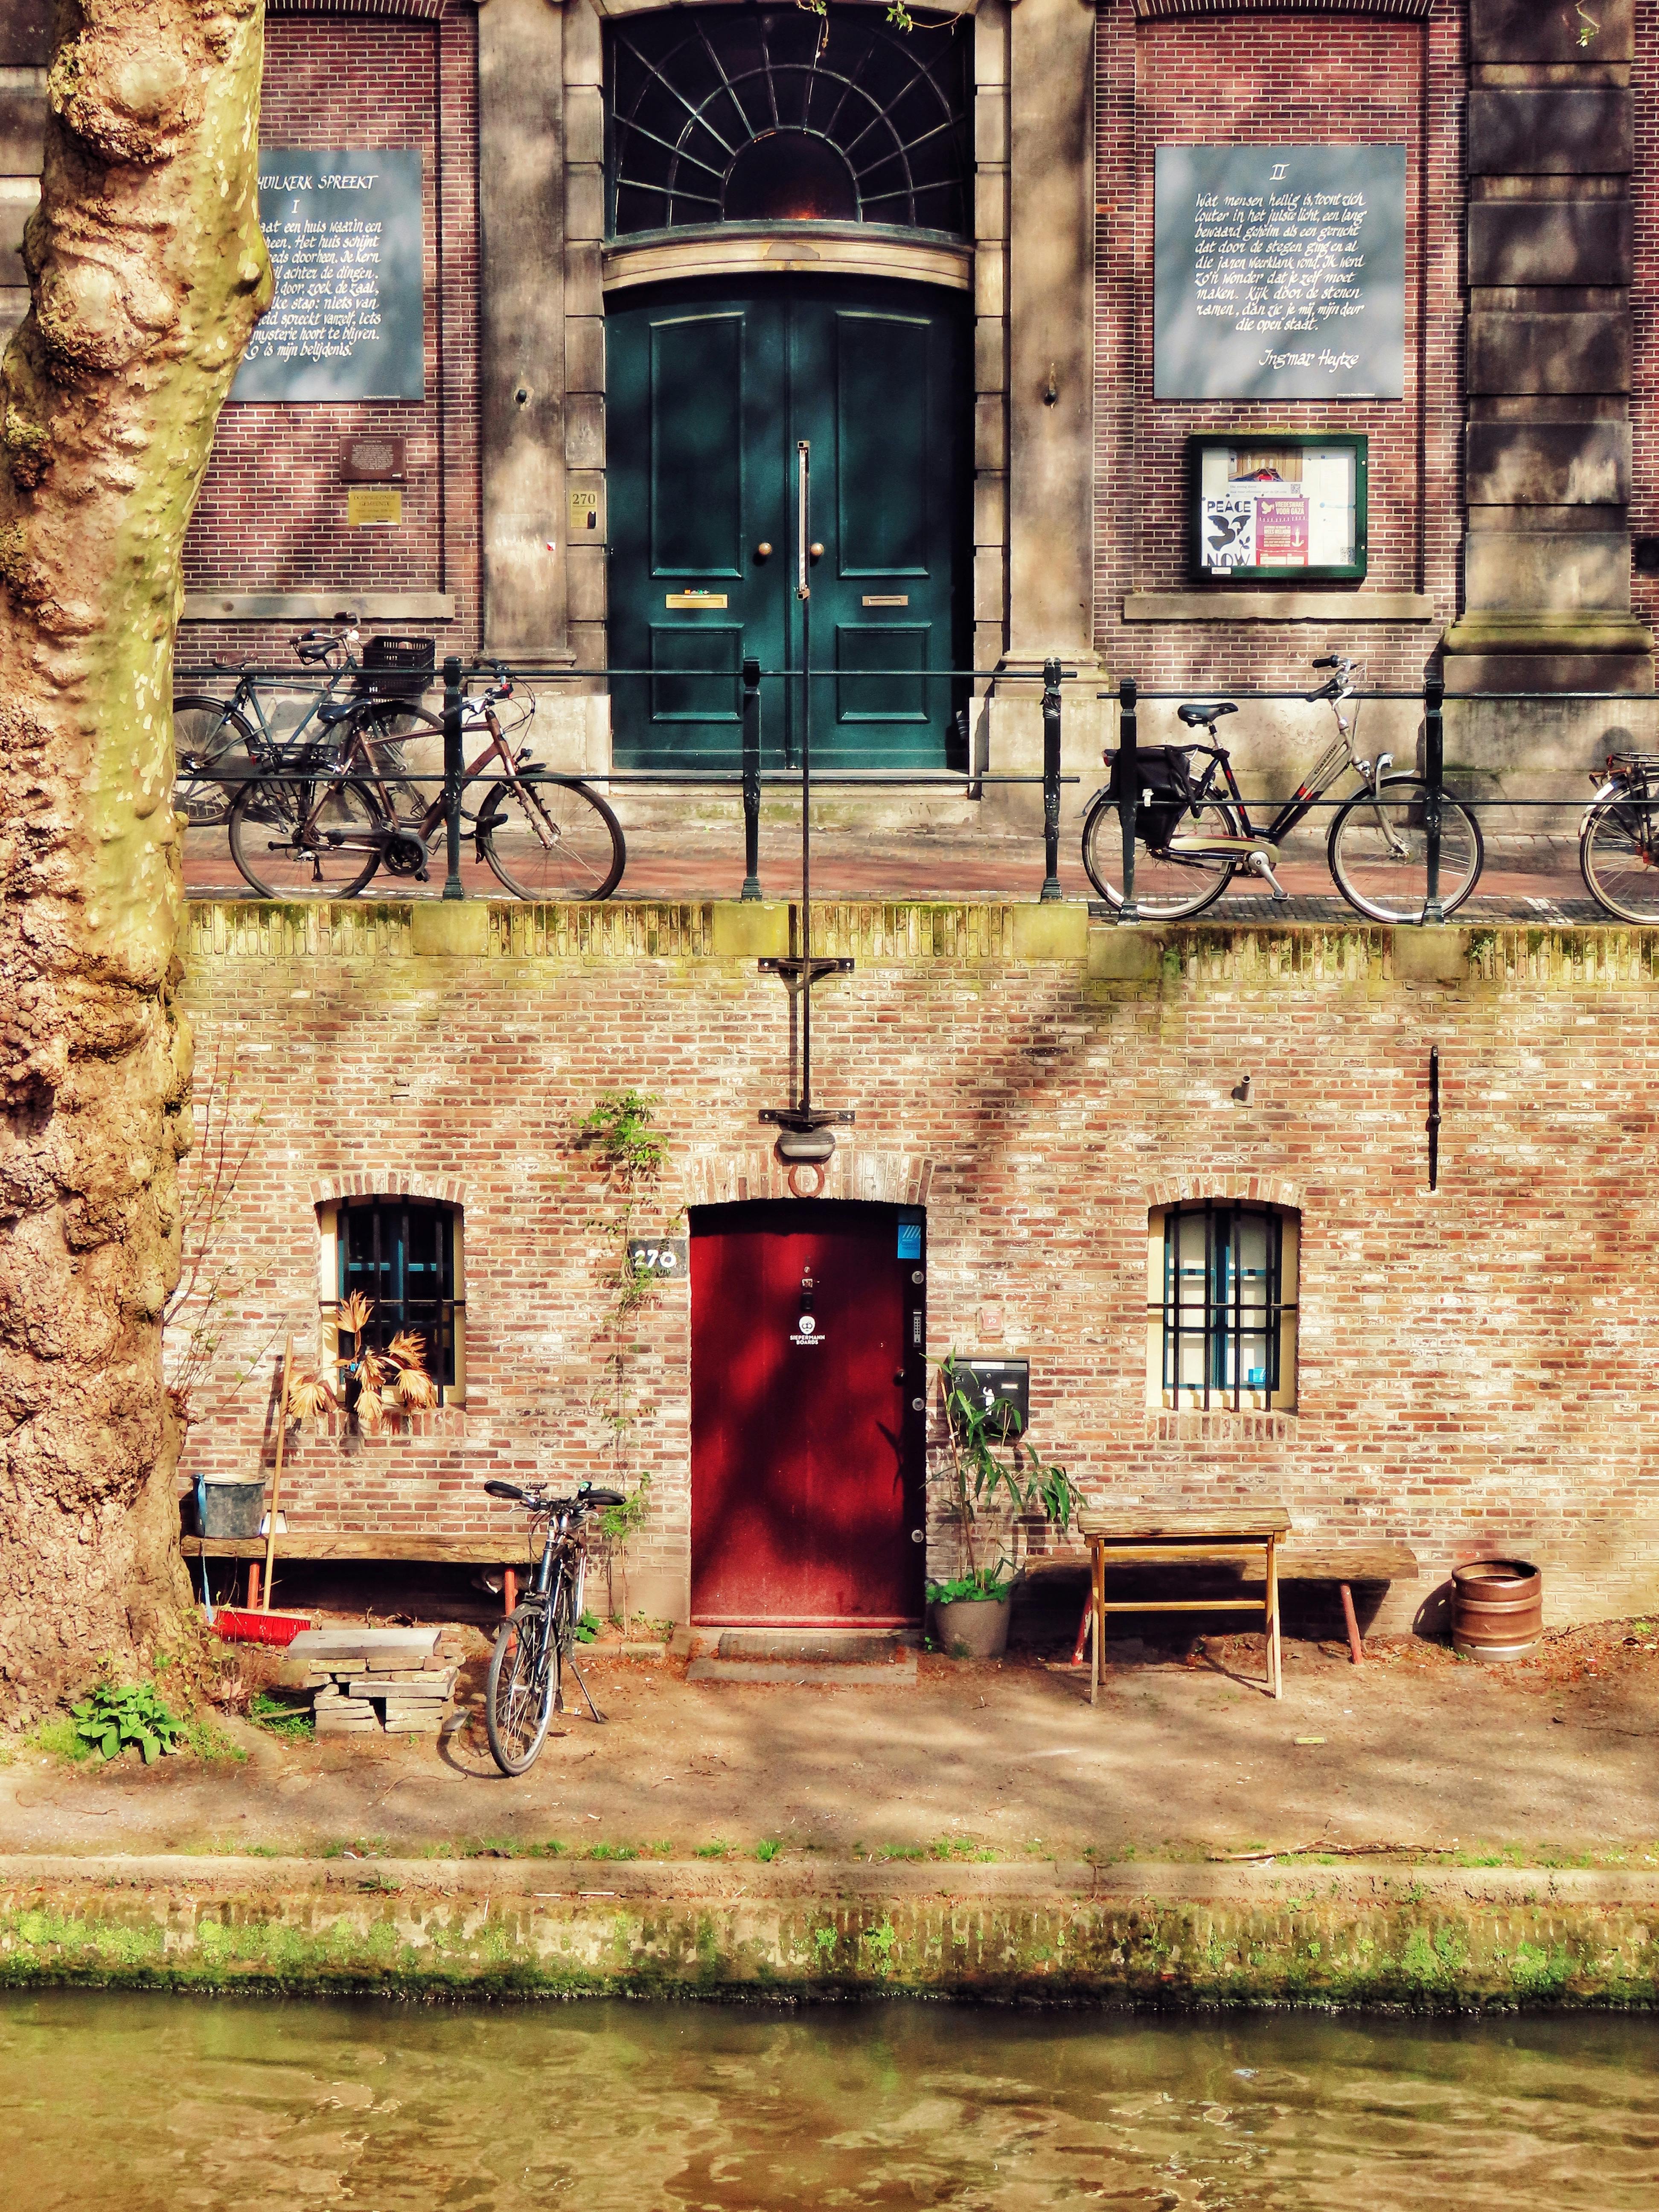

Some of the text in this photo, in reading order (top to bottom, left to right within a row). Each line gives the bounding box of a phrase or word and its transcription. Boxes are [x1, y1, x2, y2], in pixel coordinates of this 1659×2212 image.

[1269, 163, 1291, 181] II
[258, 175, 379, 191] HUILKERK SPREEKT
[291, 200, 300, 213] I
[1196, 192, 1219, 207] Wat
[1224, 196, 1264, 207] mensen
[1314, 192, 1342, 206] toont
[1342, 192, 1366, 206] zich
[260, 218, 383, 233] aat een huis waarin een
[1195, 207, 1368, 228] louter in het juiste licht, een lang
[1194, 223, 1361, 242] bewaard geheim als een gerucht
[266, 235, 381, 252] heen. Het huis schijnt
[1195, 240, 1359, 257] dat door de stegen ging en al
[270, 250, 289, 264] eds
[292, 250, 338, 264] doorheen.
[355, 250, 381, 263] kern
[1195, 255, 1214, 269] die
[1215, 256, 1246, 274] jaren
[283, 266, 318, 279] achter
[321, 266, 334, 279] de
[337, 266, 378, 282] dingen.
[1222, 271, 1265, 284] wonder
[1266, 271, 1288, 284] dat
[1284, 271, 1299, 289] je
[1299, 269, 1323, 286] zelf
[1323, 272, 1357, 283] moet
[280, 281, 306, 296] door,
[307, 282, 333, 297] zoek
[335, 282, 348, 294] de
[1196, 285, 1363, 306] maken. Kijk door de stenen
[271, 296, 380, 312] lke stap: niets van
[1242, 302, 1266, 315] dan
[1267, 303, 1283, 317] zie
[1281, 303, 1296, 320] je
[1317, 302, 1340, 320] mijn
[1340, 302, 1365, 317] deur
[258, 311, 278, 326] eid
[281, 312, 323, 328] spreekt
[1235, 317, 1318, 334] die open staat.
[252, 327, 380, 345] mysterie hoort te blijven.
[264, 343, 274, 356] is
[277, 343, 298, 362] mijn
[300, 342, 352, 362] belijdenis.
[1259, 349, 1316, 370] Ingmar
[572, 493, 595, 504] 270
[1207, 501, 1251, 512] PEACE
[1207, 553, 1250, 566] NOW
[1314, 744, 1337, 774] Gazelle
[634, 1249, 676, 1268] 270
